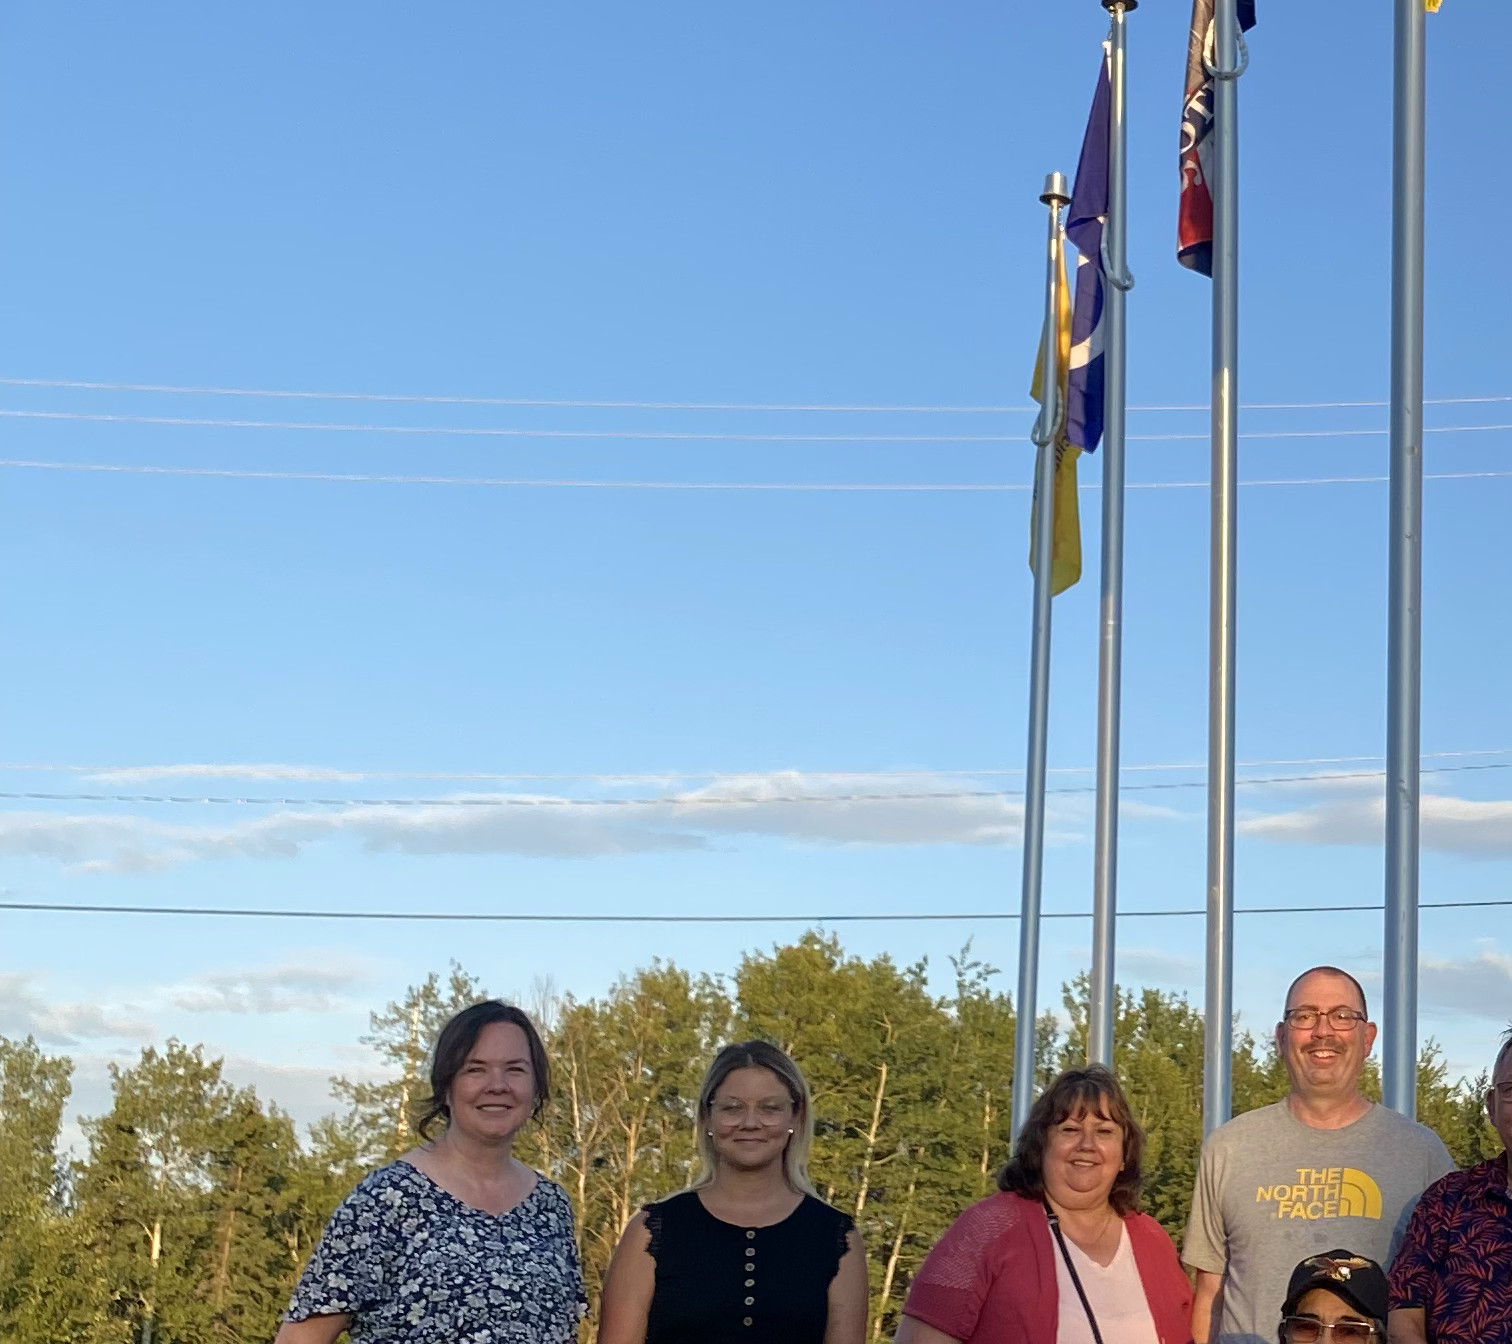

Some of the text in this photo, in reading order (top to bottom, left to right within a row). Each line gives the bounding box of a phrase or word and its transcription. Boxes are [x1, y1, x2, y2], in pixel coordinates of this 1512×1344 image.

[1296, 1167, 1341, 1185] THE
[1256, 1183, 1340, 1202] NORTH
[1278, 1200, 1338, 1220] FACE
